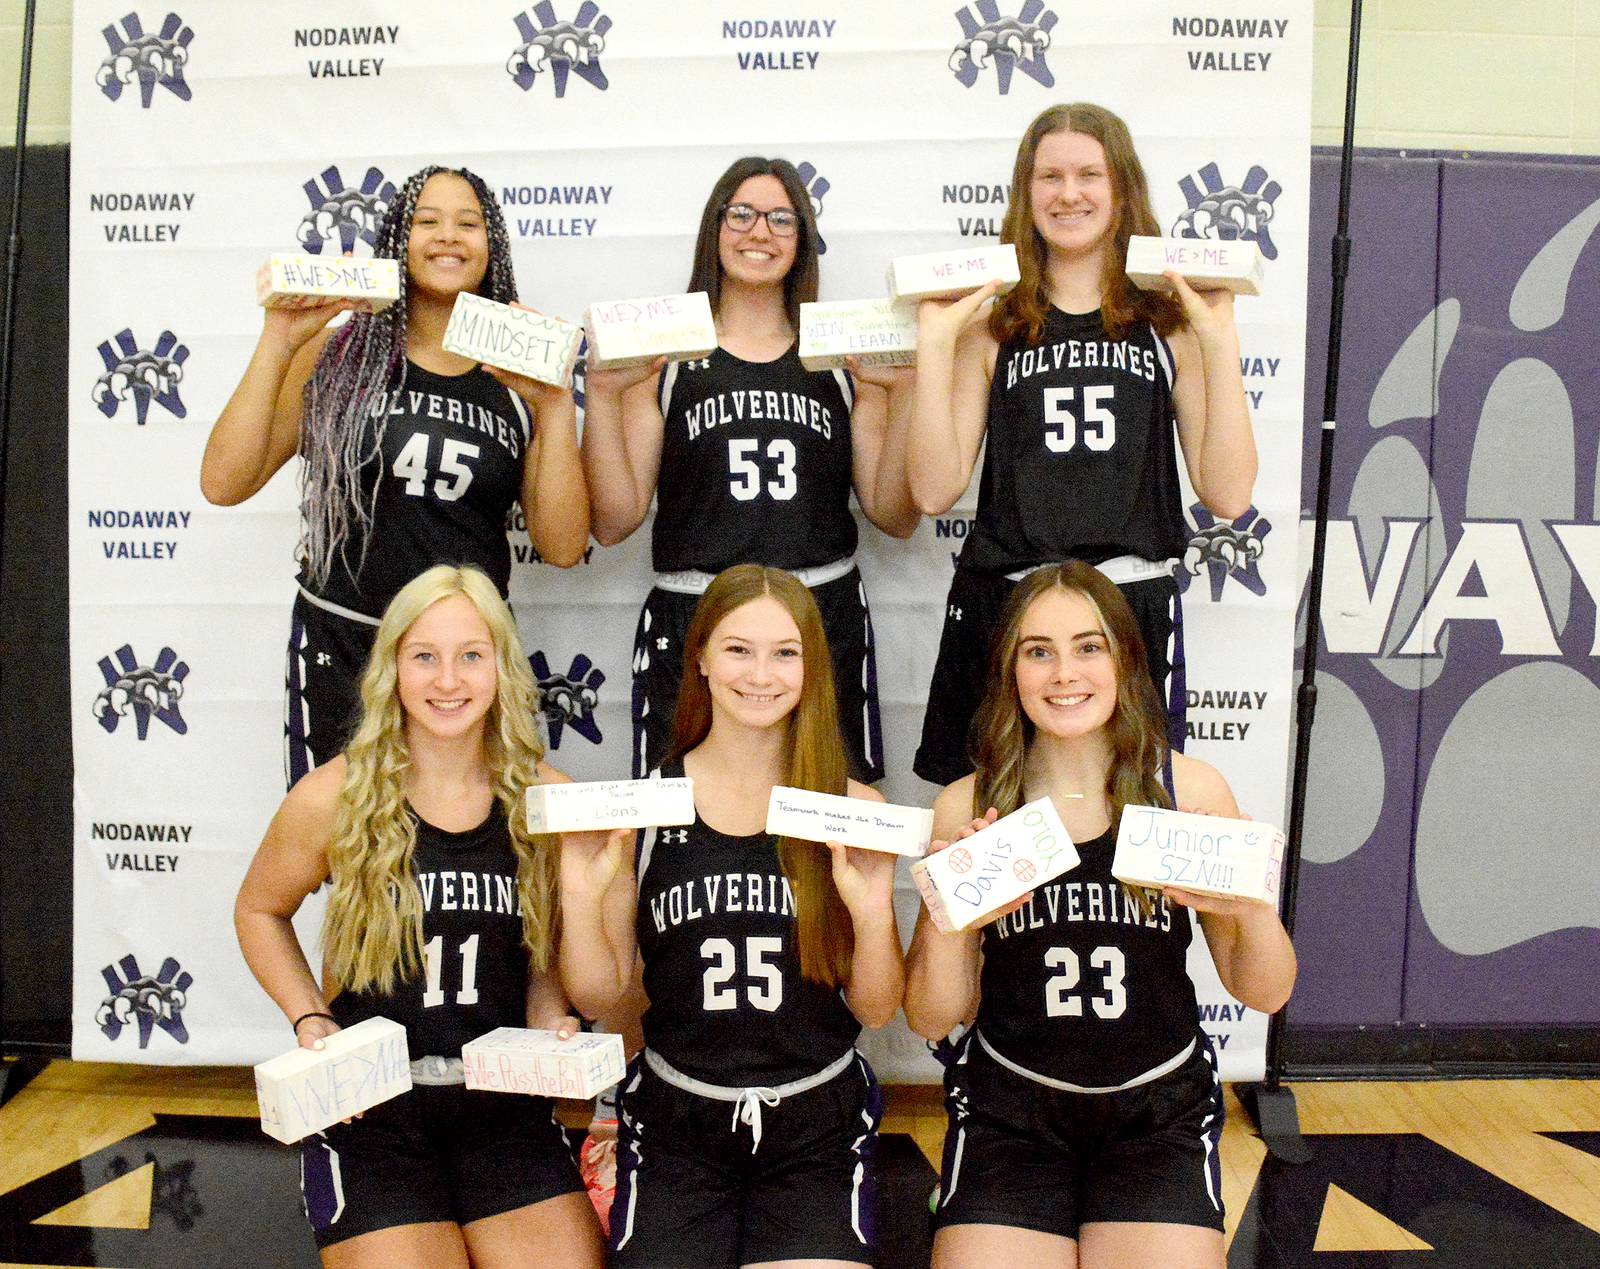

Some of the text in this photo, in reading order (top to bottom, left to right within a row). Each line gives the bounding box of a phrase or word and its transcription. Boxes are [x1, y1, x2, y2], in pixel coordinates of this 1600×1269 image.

[294, 25, 399, 47] NODAWAY
[722, 20, 836, 38] NODAWAY
[1172, 17, 1288, 38] NODAWAY
[308, 58, 384, 78] VALLEY
[737, 51, 819, 70] VALLEY
[1187, 51, 1272, 71] VALLEY
[89, 193, 195, 211] NODAWAY
[502, 186, 613, 205] NODAWAY
[942, 184, 1011, 204] NODA
[104, 224, 180, 242] VALLEY
[517, 218, 597, 236] VALLEY
[957, 217, 1001, 236] VAL
[457, 310, 556, 364] MINDSET
[849, 332, 902, 349] LEARN
[1007, 340, 1155, 390] WOLVERINES
[371, 390, 519, 460] OLVERINES
[685, 390, 832, 441] WOLVERINES
[1043, 385, 1116, 453] 55
[392, 432, 481, 501] 45
[728, 438, 798, 501] 53
[88, 510, 191, 528] NODAWAY
[103, 541, 177, 559] VALLEY
[1186, 690, 1268, 710] DAWAY
[1185, 721, 1250, 740] ALLEY
[776, 800, 819, 815] Teamwork
[873, 816, 904, 828] Dream
[92, 823, 192, 843] NODAWAY
[1023, 810, 1064, 873] YOLO
[1128, 810, 1232, 857] Junior
[106, 853, 178, 872] VALLEY
[953, 837, 1012, 906] Davis
[650, 873, 798, 933] WOLVERIN
[423, 933, 479, 1008] 11
[700, 937, 783, 1012] 25
[1044, 946, 1126, 1019] 23
